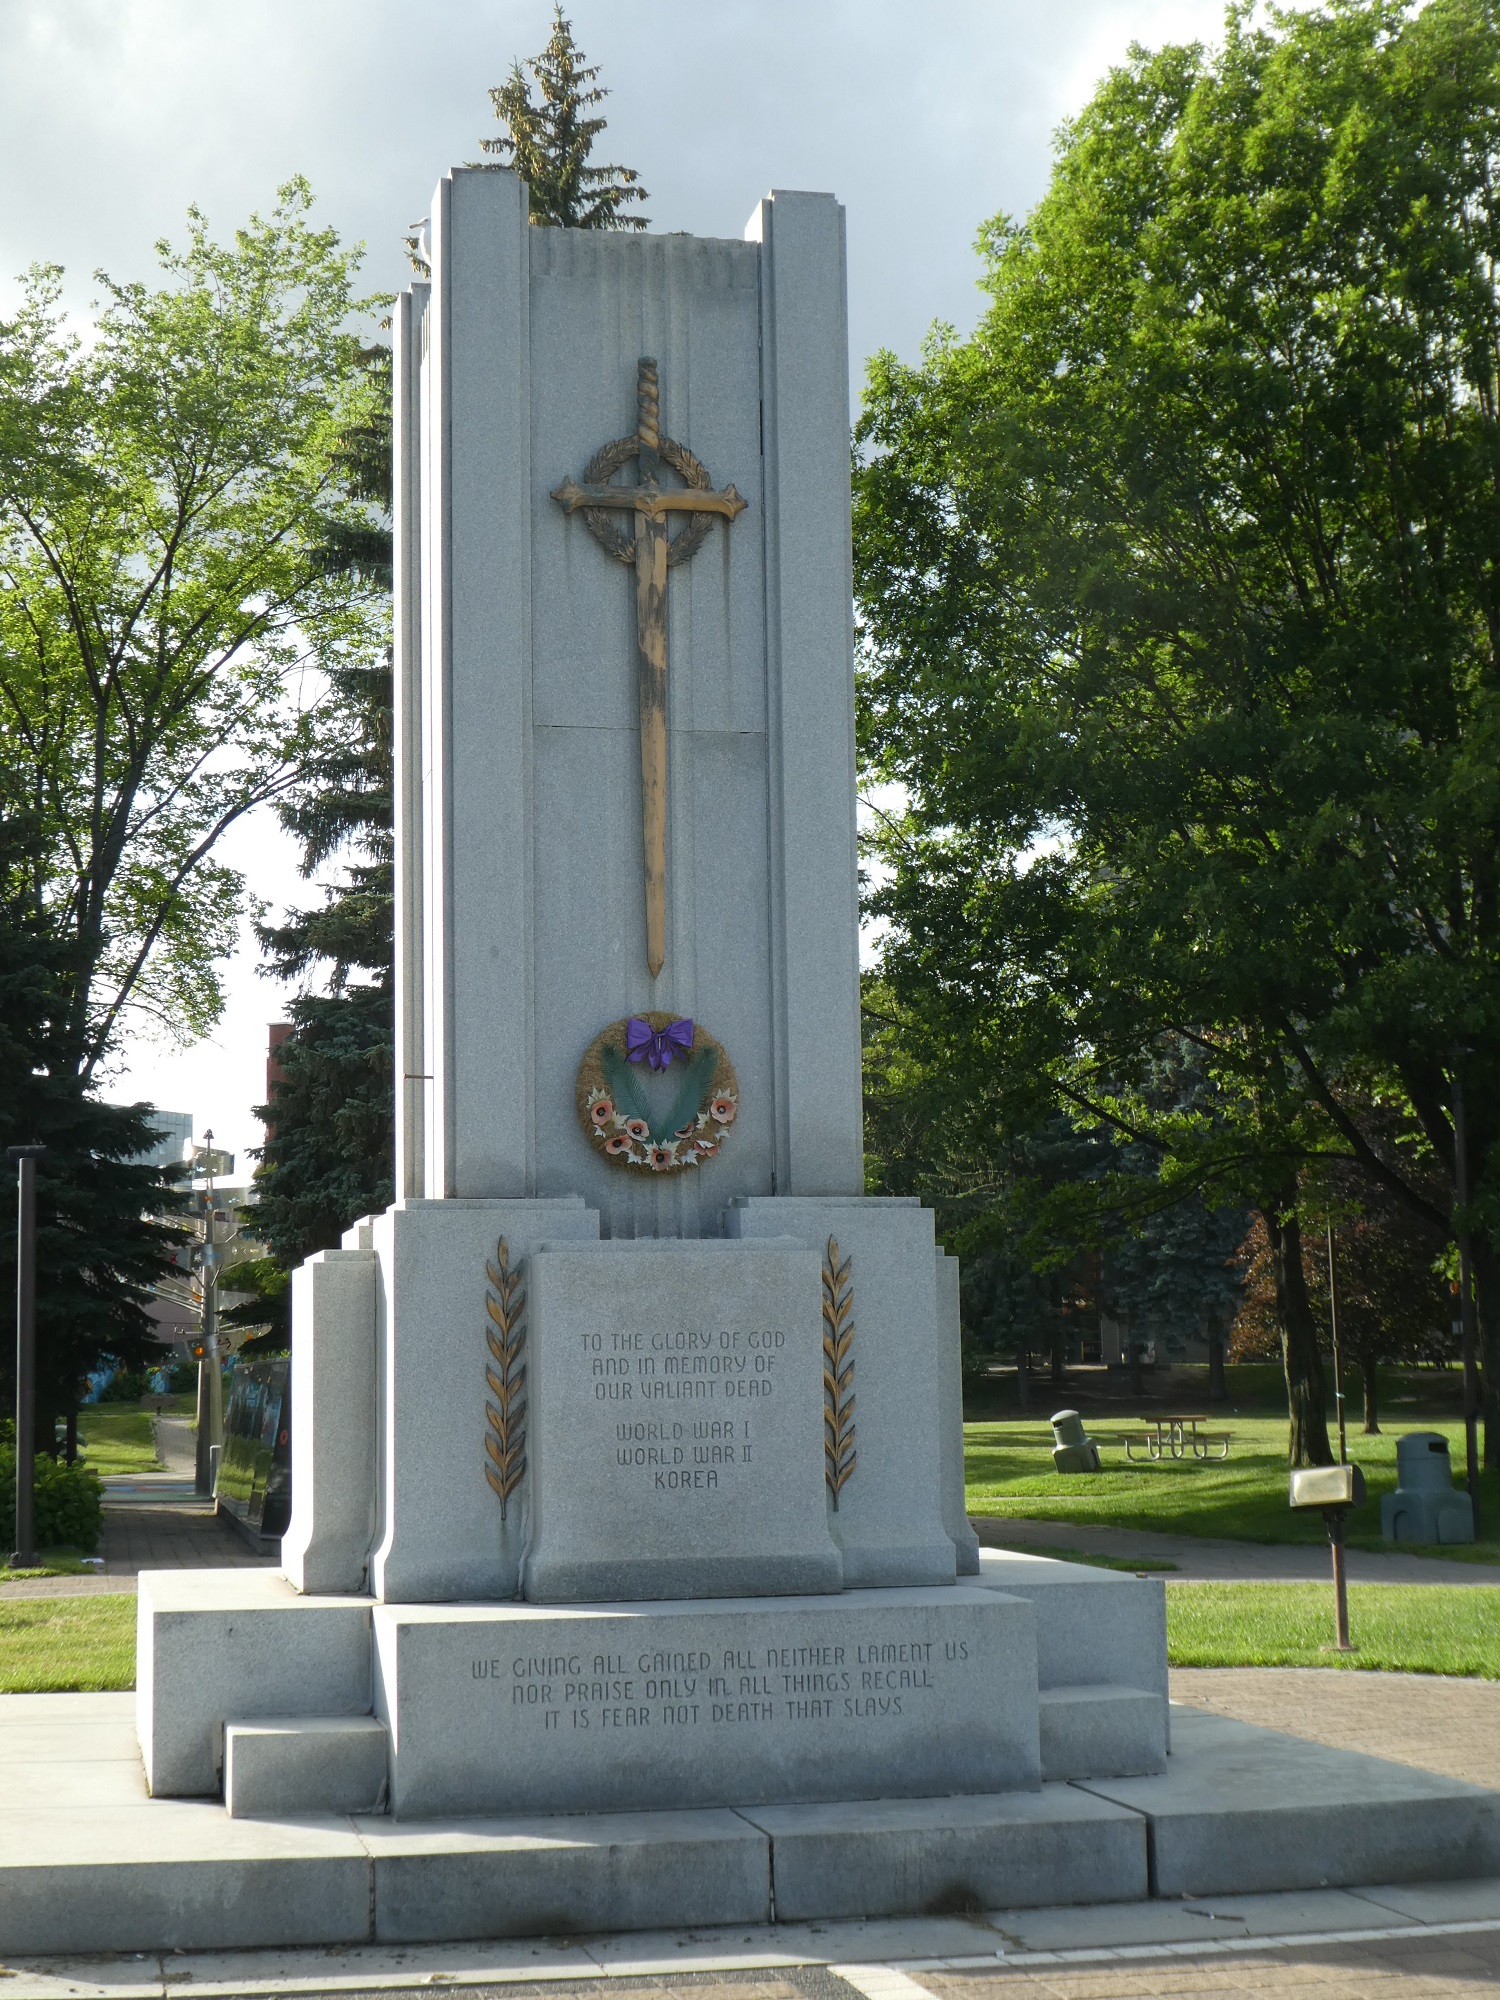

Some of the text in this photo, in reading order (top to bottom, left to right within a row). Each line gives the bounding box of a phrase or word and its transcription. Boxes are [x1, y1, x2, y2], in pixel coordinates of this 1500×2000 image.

[581, 1331, 785, 1351] TO THE GLORY OF GOD
[593, 1356, 775, 1375] AND IN MEMORY OF
[595, 1380, 772, 1400] OUR VALIANT DEAD
[616, 1421, 750, 1441] WORLD WAR I
[616, 1445, 752, 1465] WORLD WAR II
[655, 1470, 718, 1489] KOREA
[472, 1660, 500, 1679] WE
[513, 1656, 581, 1677] GIVING
[638, 1652, 711, 1673] GAINED
[723, 1651, 756, 1670] ALL
[767, 1647, 845, 1668] NEITHER
[858, 1644, 932, 1664] LAMENT
[945, 1642, 968, 1661] US
[512, 1684, 552, 1704] NOR
[646, 1679, 696, 1699] ONLY
[709, 1678, 727, 1696] IN
[740, 1676, 772, 1695] ALL
[782, 1673, 850, 1693] THINGS
[545, 1710, 561, 1729] IT
[573, 1709, 589, 1729] IS
[602, 1708, 650, 1727] FEAR
[663, 1705, 700, 1724] NOT
[712, 1702, 773, 1723] DEATH
[785, 1700, 833, 1720] THAT
